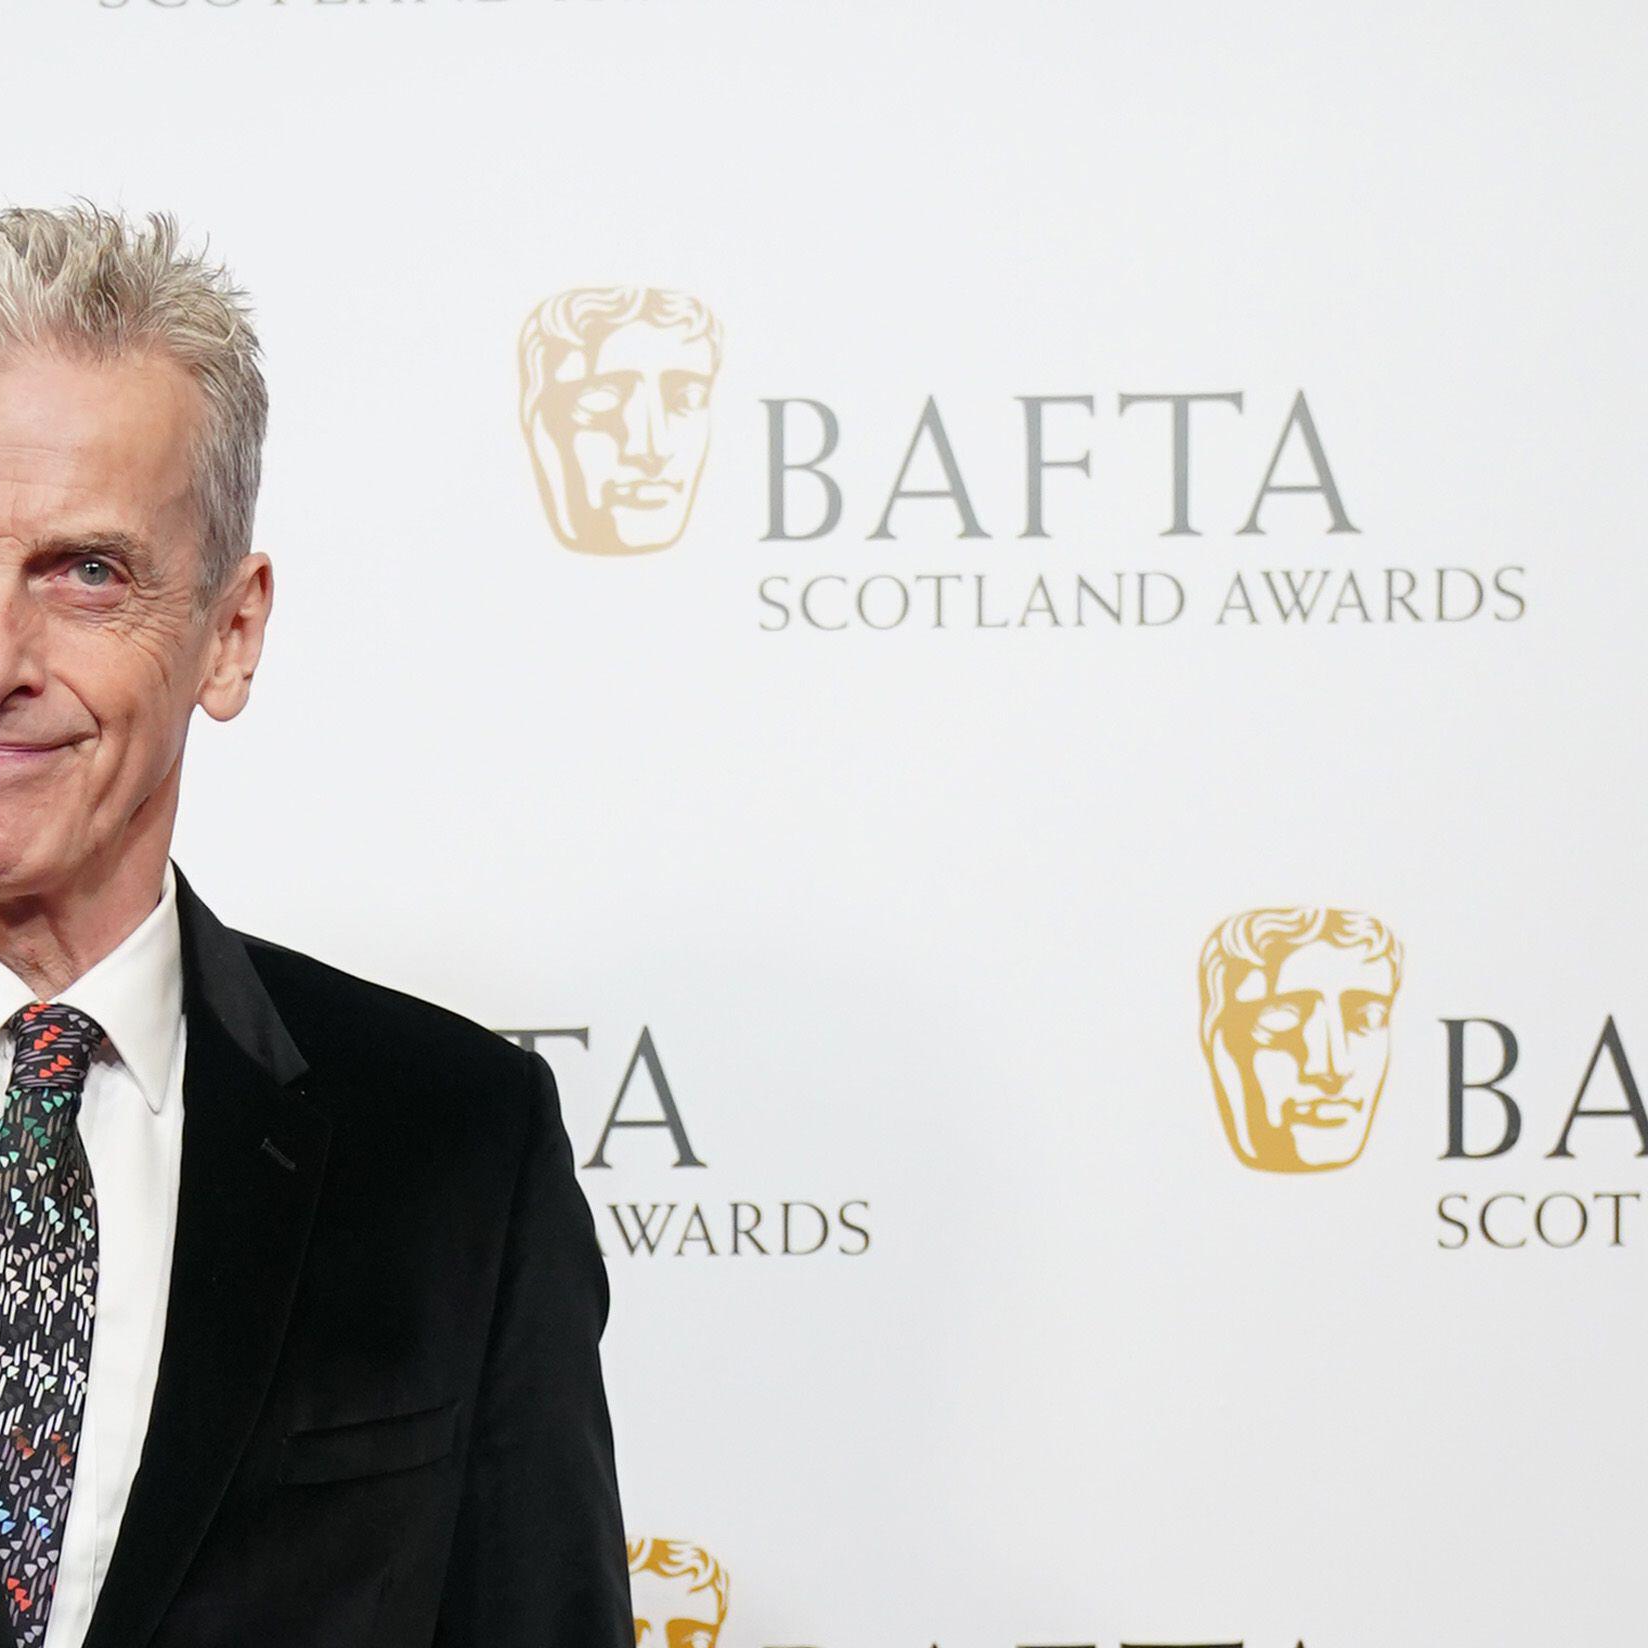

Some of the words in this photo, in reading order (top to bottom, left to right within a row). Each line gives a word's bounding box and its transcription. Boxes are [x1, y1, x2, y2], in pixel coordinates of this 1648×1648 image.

[760, 390, 1362, 541] BAFTA
[758, 572, 1186, 629] SCOTLAND
[1214, 566, 1529, 625] AWARDS
[595, 1200, 870, 1258] WARDS
